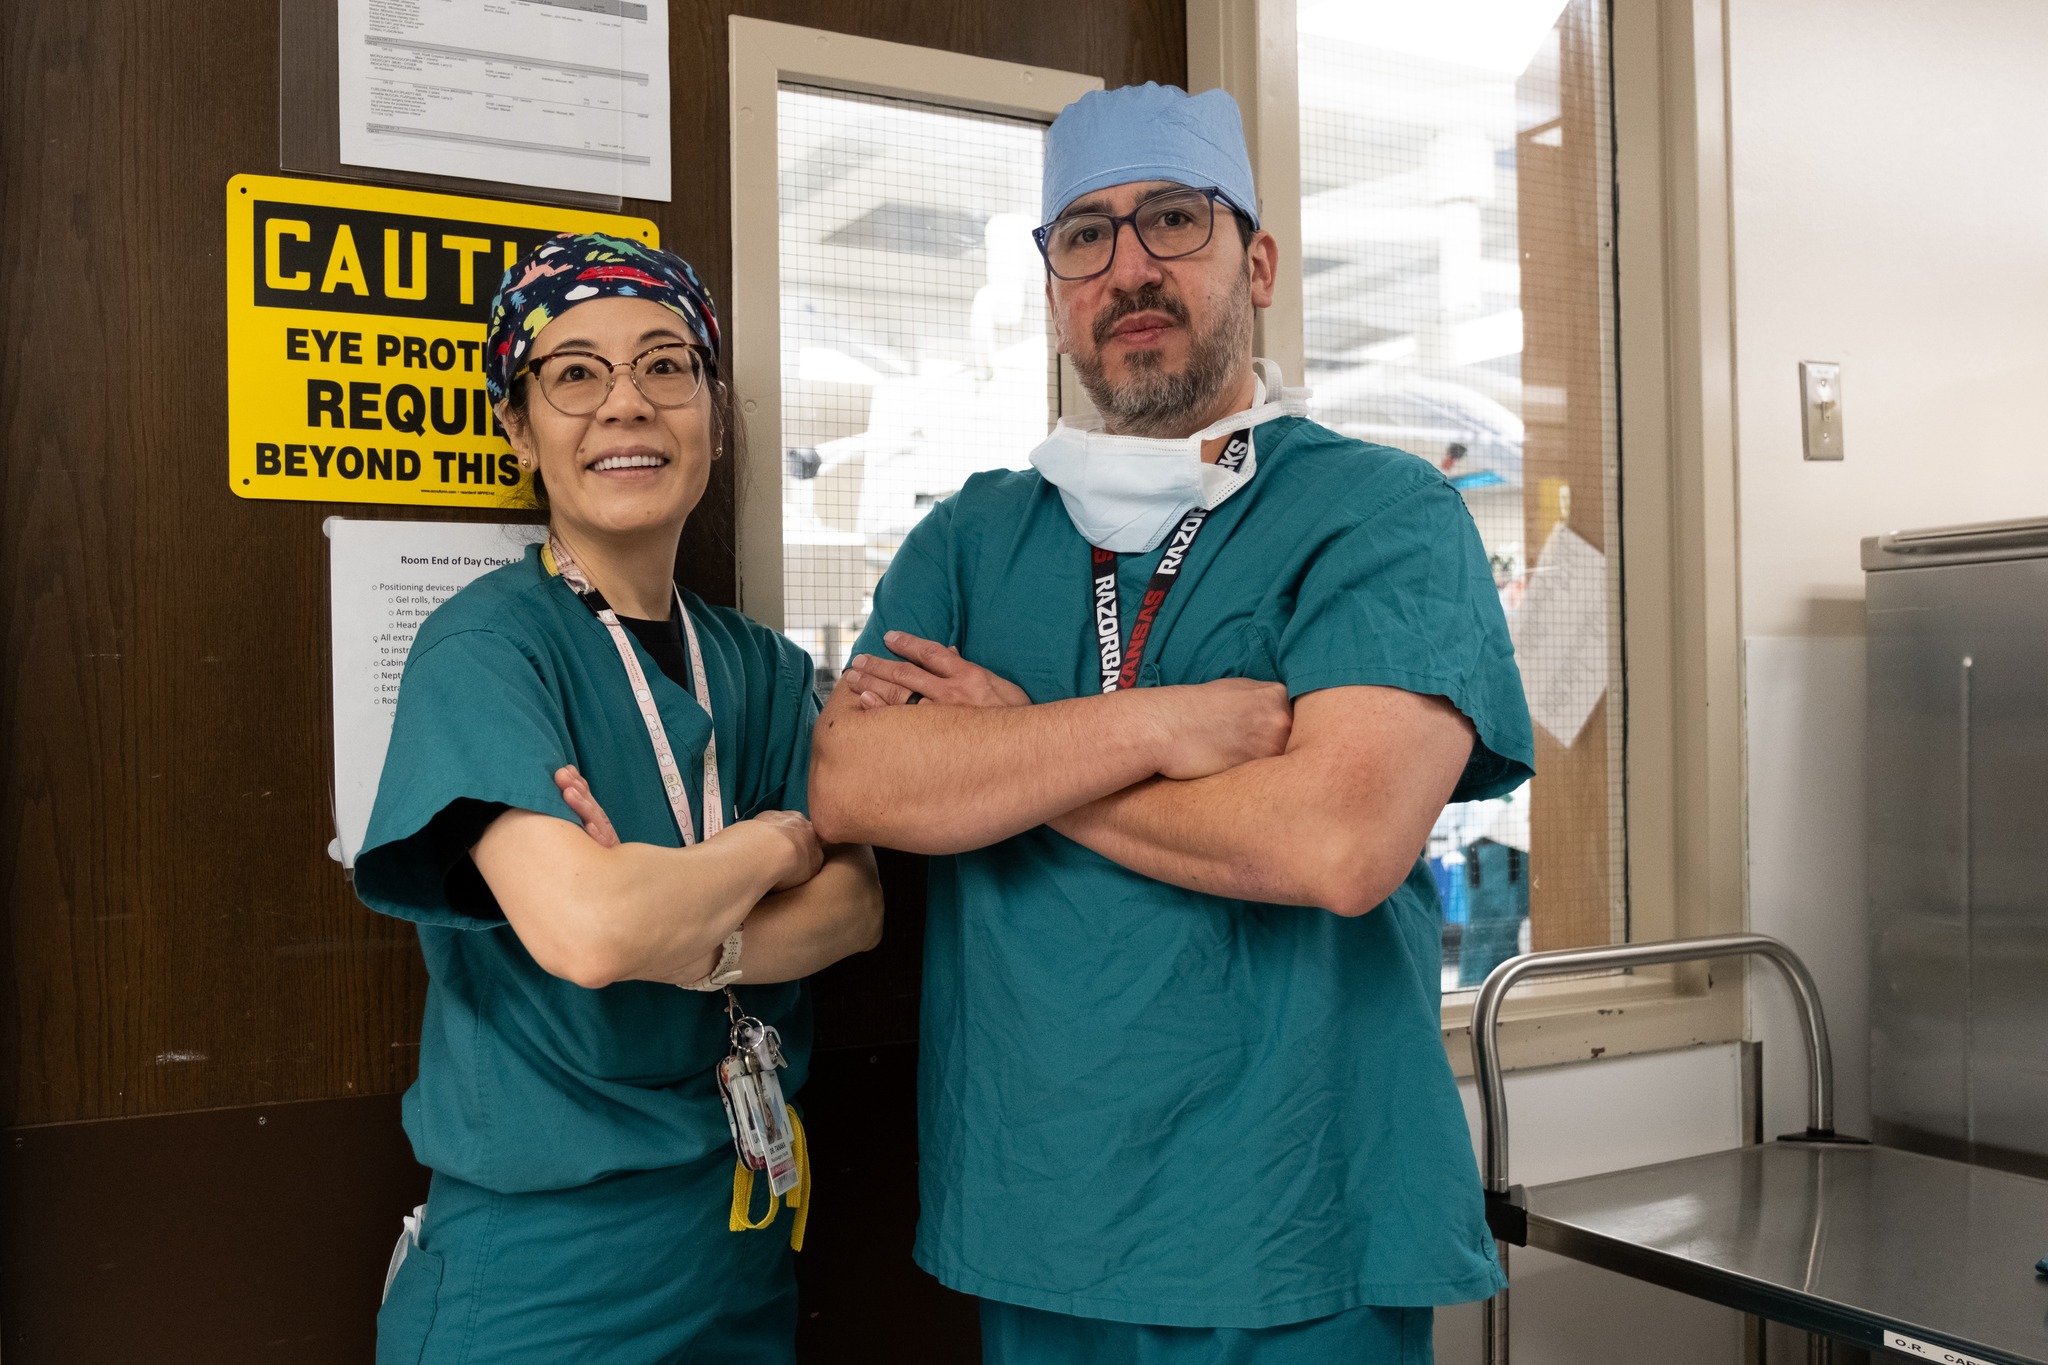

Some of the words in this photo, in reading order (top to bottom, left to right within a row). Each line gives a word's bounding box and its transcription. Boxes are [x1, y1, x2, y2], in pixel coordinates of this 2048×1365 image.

[265, 217, 518, 305] CAUT
[286, 327, 363, 366] EYE
[255, 442, 421, 482] BEYOND
[433, 451, 521, 487] THIS
[401, 556, 429, 565] Room
[431, 557, 449, 565] End
[451, 557, 462, 566] of
[464, 558, 482, 567] Day
[484, 557, 511, 566] Check
[379, 583, 424, 592] Positioning
[425, 584, 455, 592] devices
[395, 596, 409, 604] Gel
[410, 596, 431, 605] rolls,
[396, 621, 417, 629] Head
[381, 633, 391, 641] All
[392, 634, 413, 642] extra
[1895, 1338, 1926, 1354] O.R.
